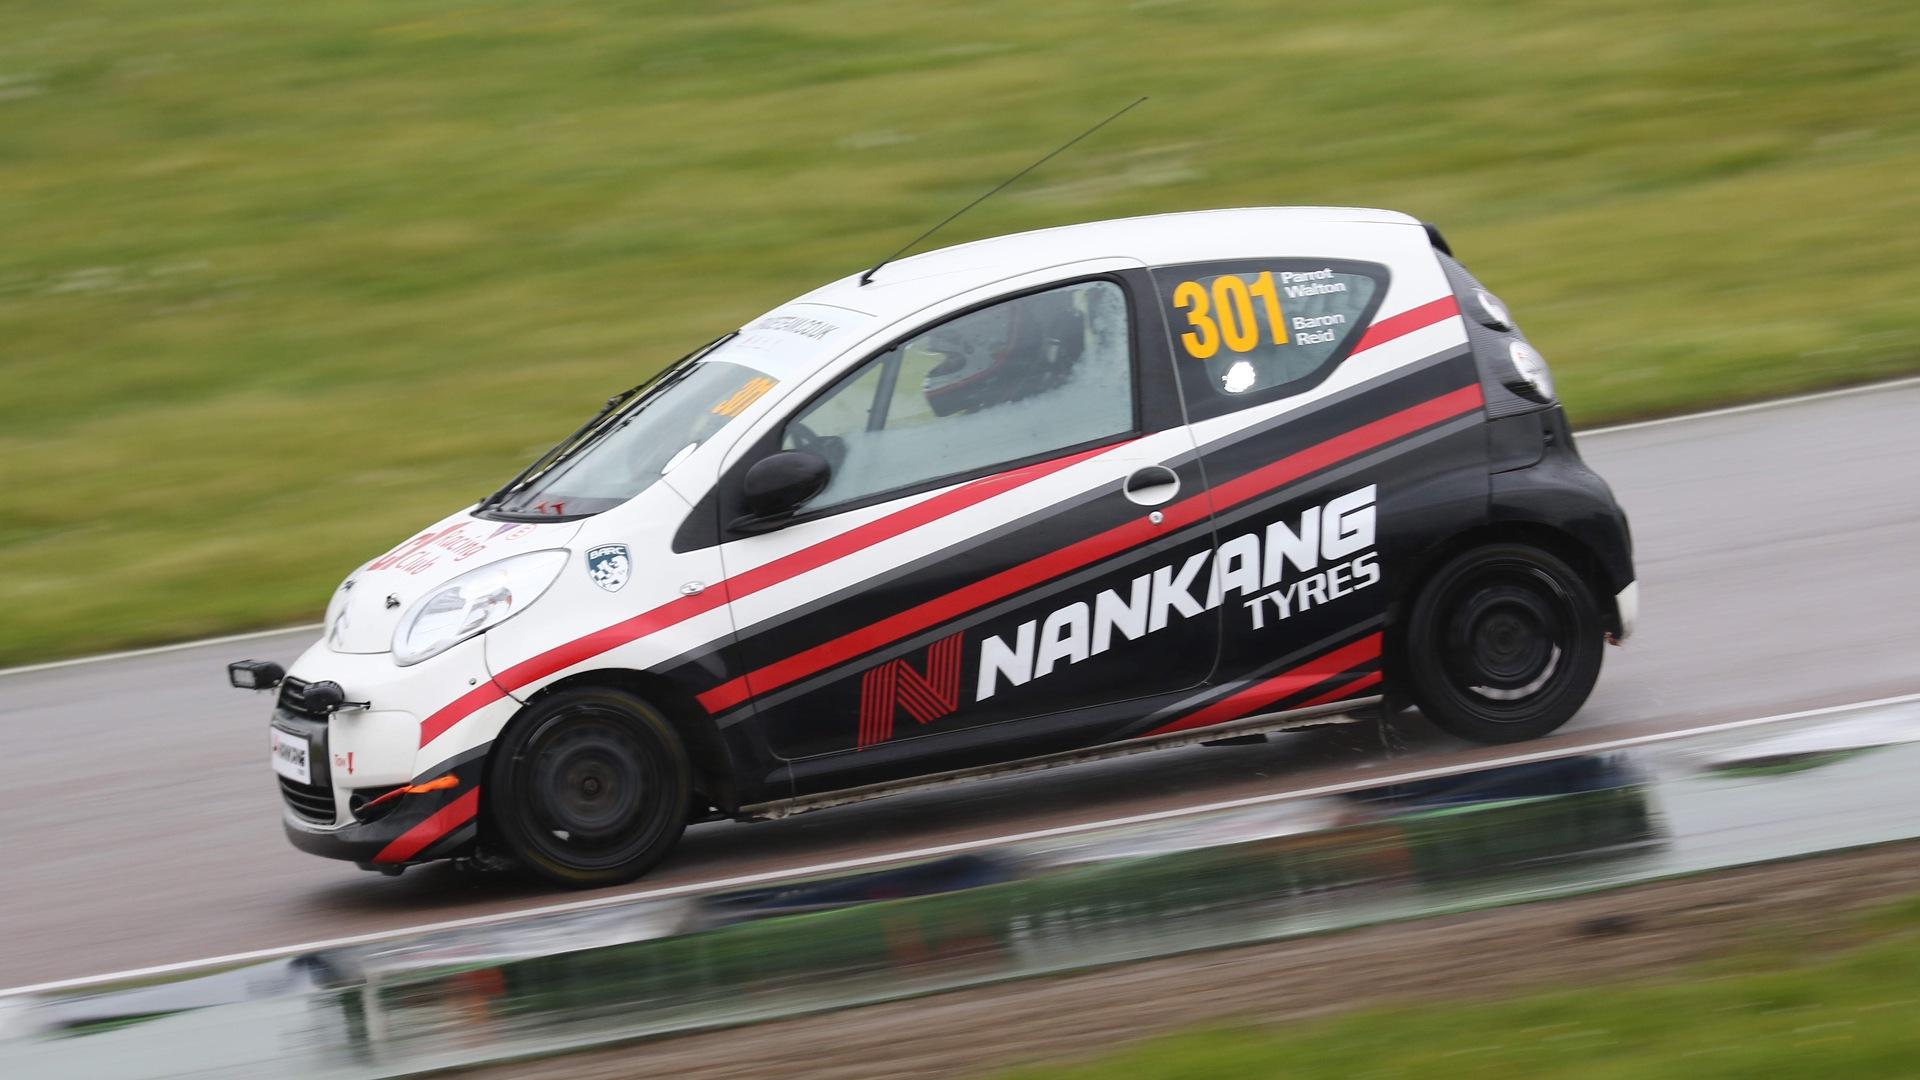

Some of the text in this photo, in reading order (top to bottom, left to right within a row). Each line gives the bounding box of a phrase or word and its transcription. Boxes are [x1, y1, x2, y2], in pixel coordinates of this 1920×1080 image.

[1280, 268, 1334, 284] Parrot
[1284, 281, 1347, 299] Walton
[1173, 270, 1290, 360] 301
[1291, 313, 1346, 331] Baron
[1295, 328, 1336, 346] Reid
[433, 529, 487, 562] Racing
[589, 546, 626, 560] BARC
[395, 550, 441, 576] Club
[976, 484, 1377, 702] NANKANG
[1244, 551, 1382, 631] TYRES
